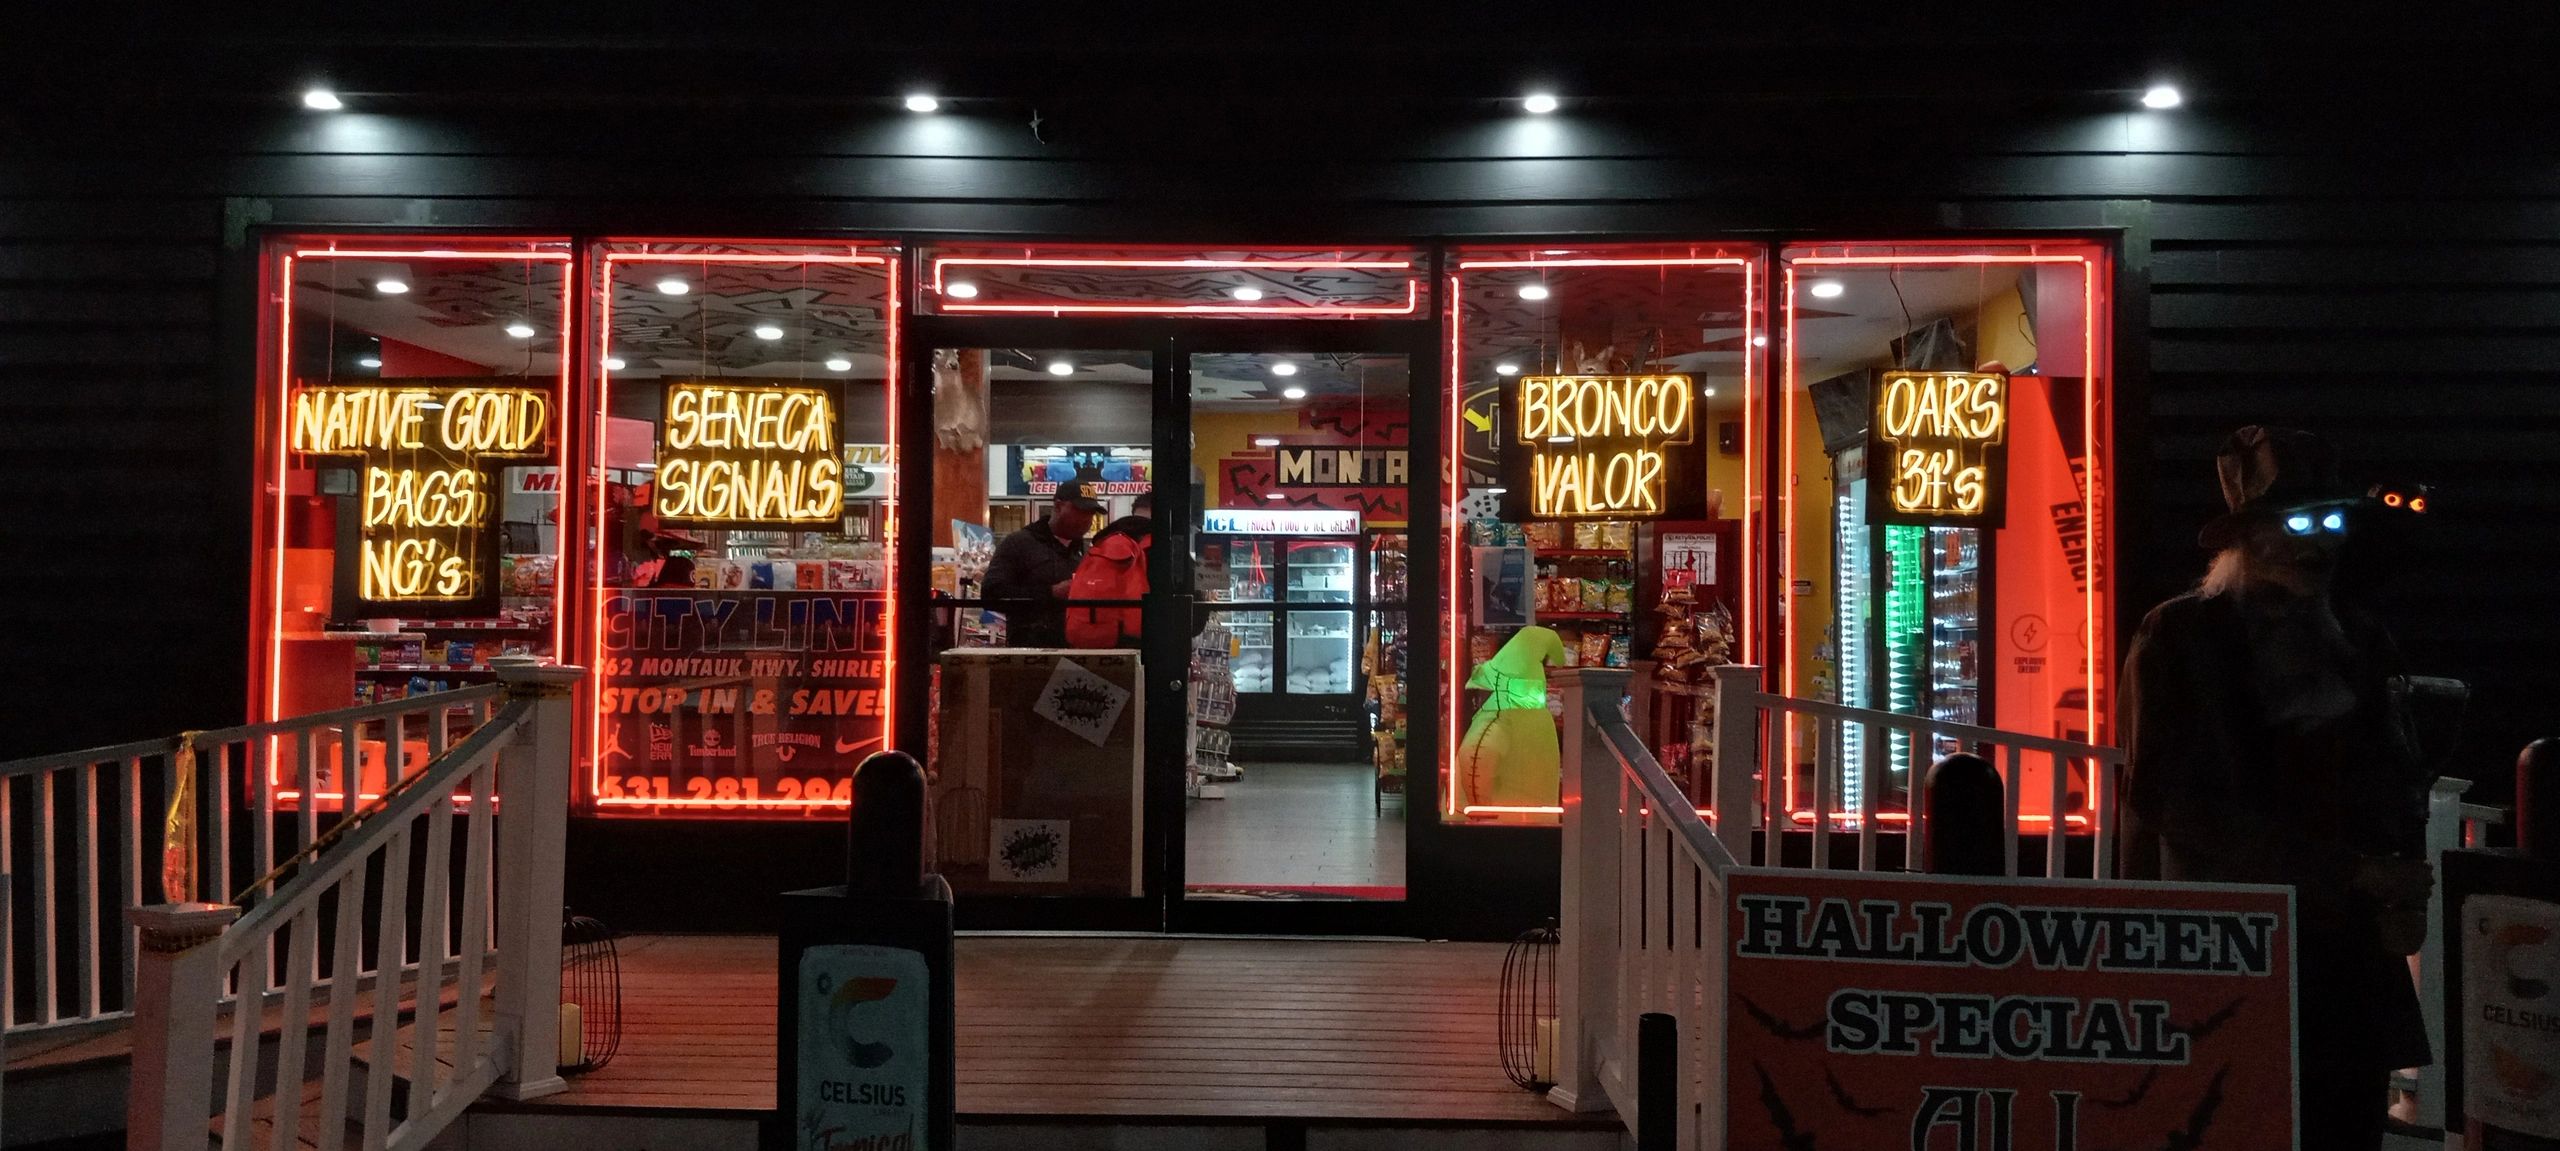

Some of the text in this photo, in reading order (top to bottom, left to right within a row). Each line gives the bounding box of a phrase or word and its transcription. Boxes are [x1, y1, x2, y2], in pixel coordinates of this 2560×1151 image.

[294, 389, 545, 453] NATIVE GOLD
[670, 387, 829, 454] SENECA
[1523, 377, 1688, 440] BRONCO
[1886, 376, 2000, 439] OARS
[364, 466, 475, 528] BAGS
[660, 458, 838, 521] SIGNALS
[1029, 482, 1057, 494] ICEE
[1107, 482, 1153, 495] DRINKS
[1280, 449, 1409, 484] MONTA
[1537, 448, 1662, 515] VALOR
[363, 538, 463, 600] NG's
[597, 596, 895, 654] CITY LINE
[640, 658, 742, 677] MONTAUK
[752, 659, 803, 678] HWY.
[811, 659, 896, 678] SHIRLEY
[599, 687, 889, 716] STOP IN & SAVE!
[688, 744, 737, 759] Timberland
[752, 732, 821, 750] TRUE RELIGION
[1736, 893, 2278, 978] HALLOWEEN
[1825, 987, 2194, 1066] SPECIAL
[2482, 1003, 2560, 1034] CELSIUS
[819, 1079, 906, 1107] CELSIUS
